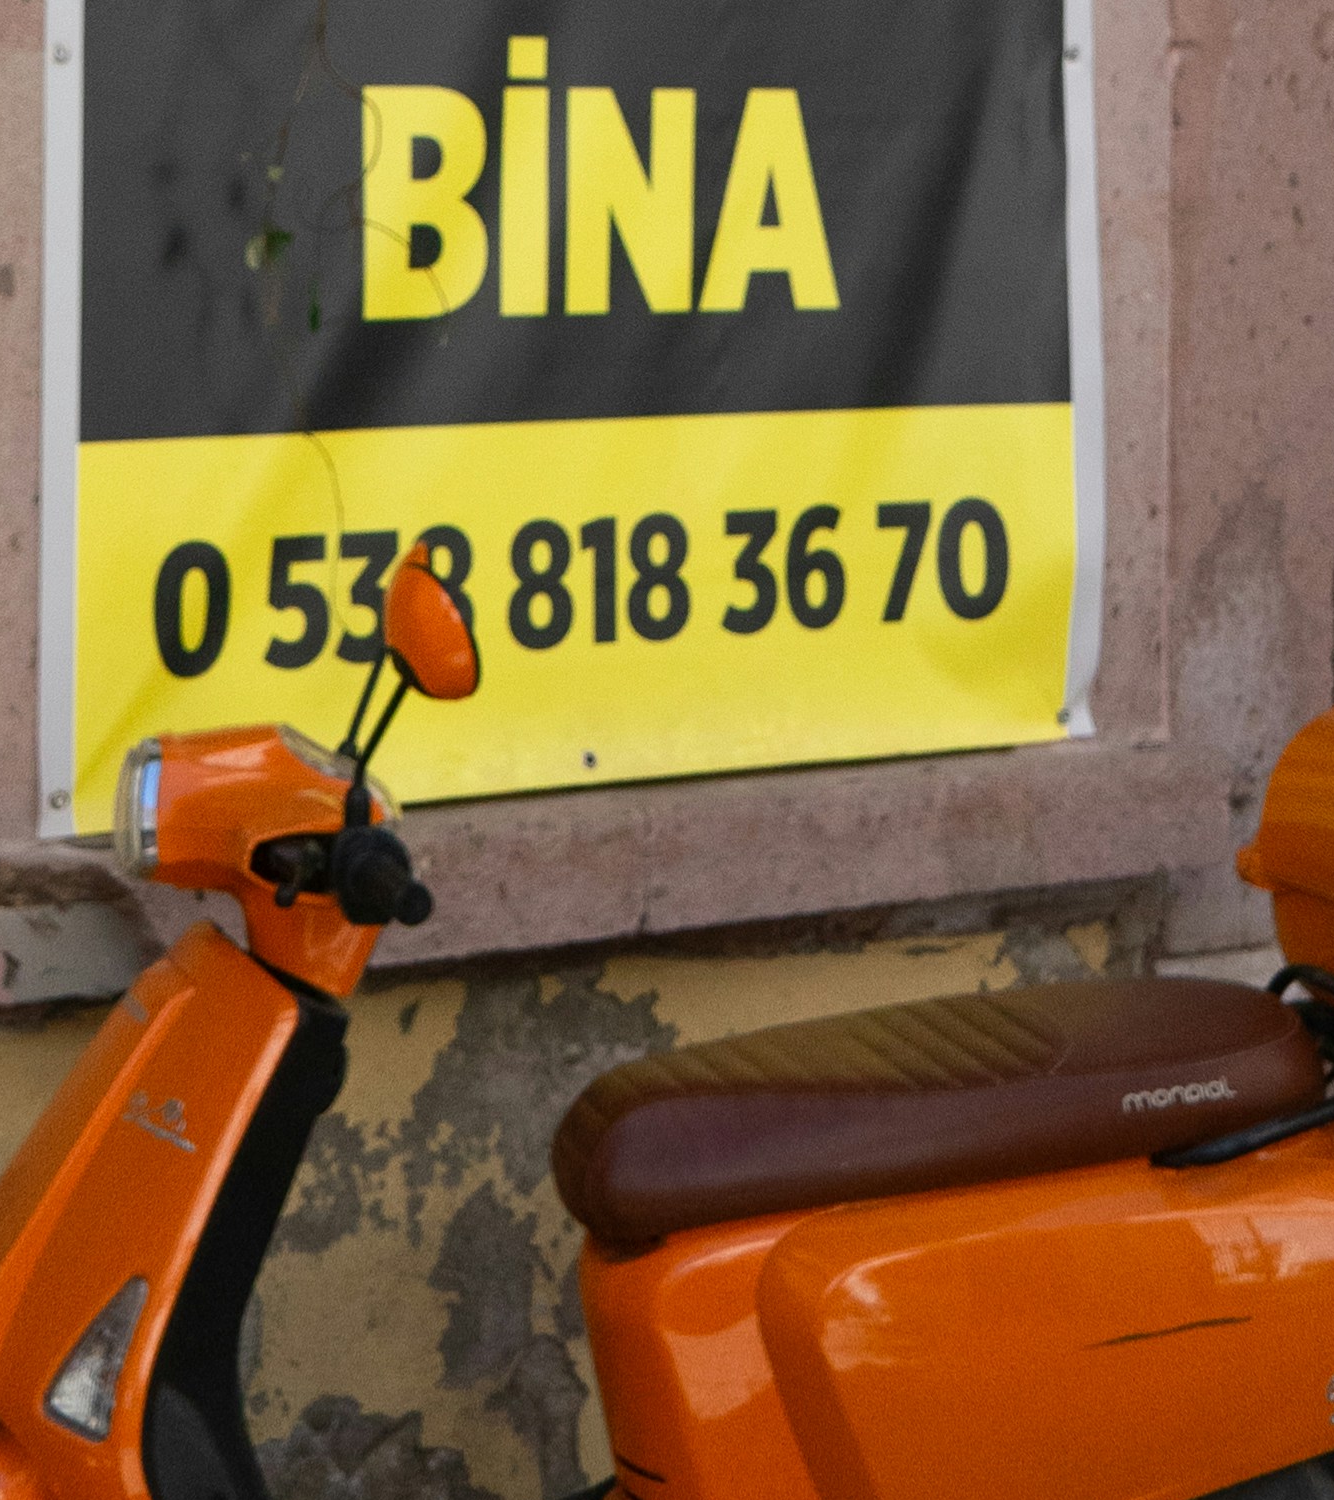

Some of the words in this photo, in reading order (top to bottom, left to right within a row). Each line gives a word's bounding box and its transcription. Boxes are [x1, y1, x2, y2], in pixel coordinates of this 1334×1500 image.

[361, 35, 842, 322] BİNA
[153, 541, 230, 679] 0
[508, 514, 690, 649] 818
[721, 504, 847, 634] 36
[877, 498, 1010, 624] 70
